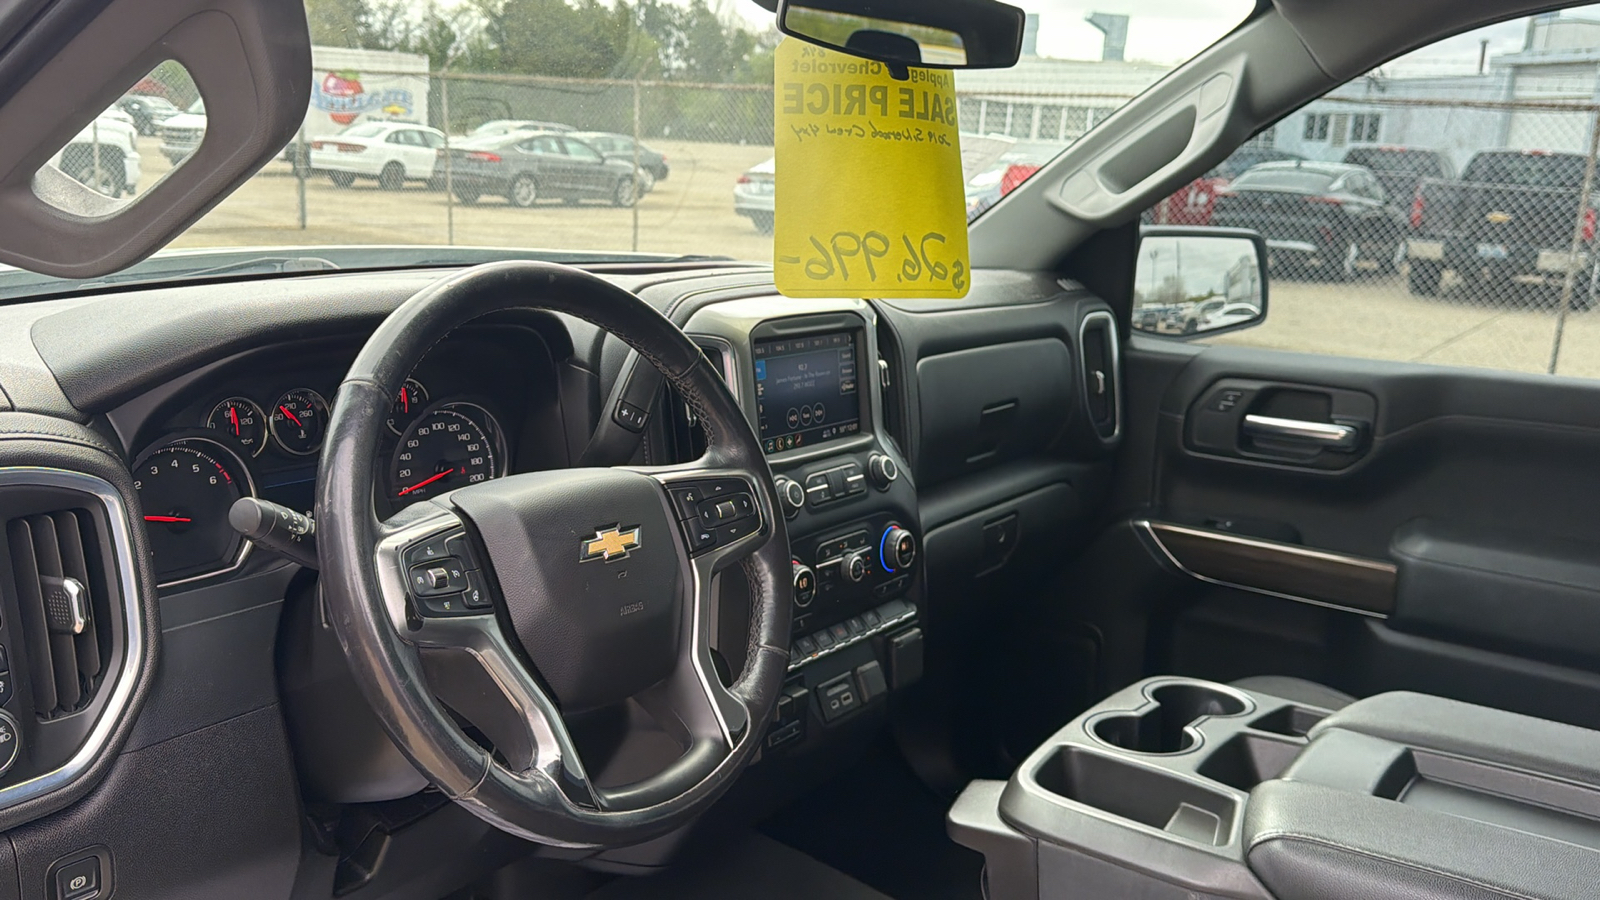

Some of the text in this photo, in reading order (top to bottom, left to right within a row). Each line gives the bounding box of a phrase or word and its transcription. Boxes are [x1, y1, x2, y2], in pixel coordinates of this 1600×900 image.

[298, 410, 313, 418] 260
[240, 416, 253, 426] 120
[431, 422, 445, 430] 100
[447, 423, 460, 431] 120
[418, 427, 430, 436] 80
[457, 433, 470, 441] 140
[407, 440, 419, 448] 60
[467, 443, 479, 452] 160
[400, 453, 411, 461] 40
[470, 457, 483, 465] 180
[171, 459, 179, 469] 4
[192, 464, 200, 473] 5
[150, 466, 159, 476] 3
[399, 468, 411, 478] 20
[209, 475, 218, 485] 6
[469, 473, 485, 482] 200
[133, 480, 142, 490] 2
[620, 602, 644, 617] AIRBAG
